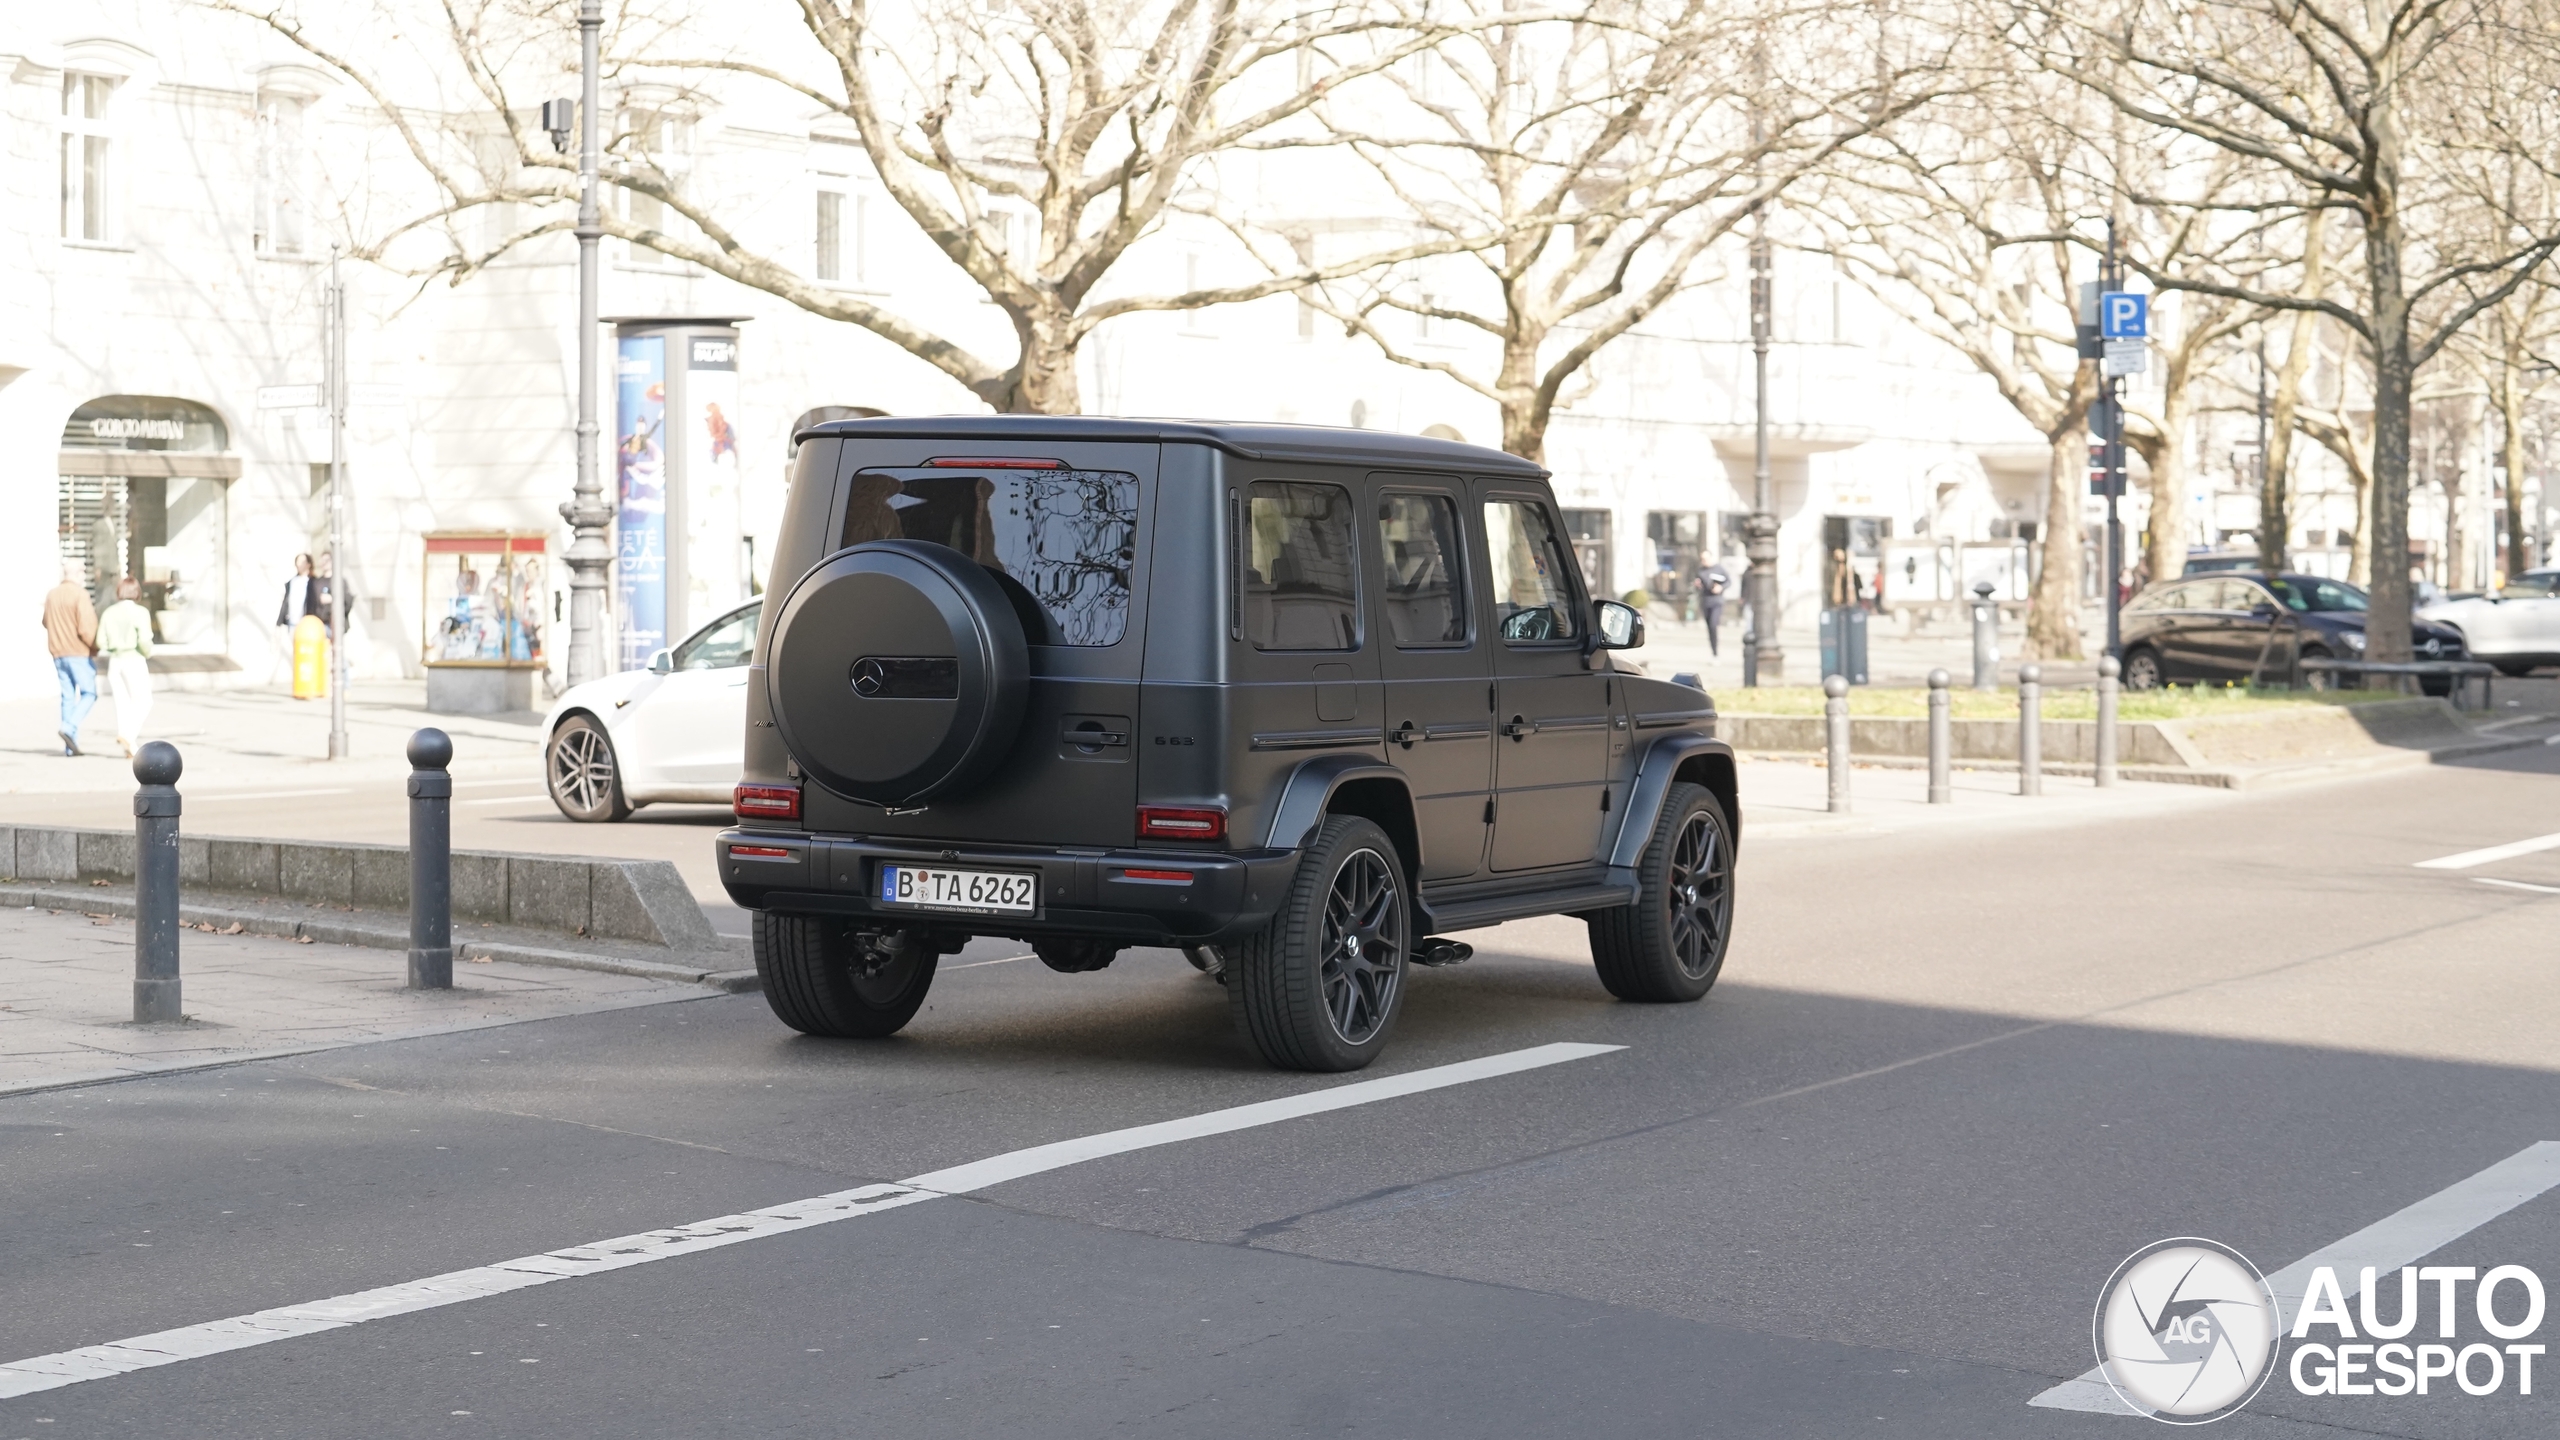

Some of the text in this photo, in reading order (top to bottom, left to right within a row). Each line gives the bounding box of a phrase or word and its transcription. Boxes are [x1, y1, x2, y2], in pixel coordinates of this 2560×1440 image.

[2112, 298, 2138, 333] P
[886, 887, 893, 896] D
[898, 871, 1031, 905] B TA 6262
